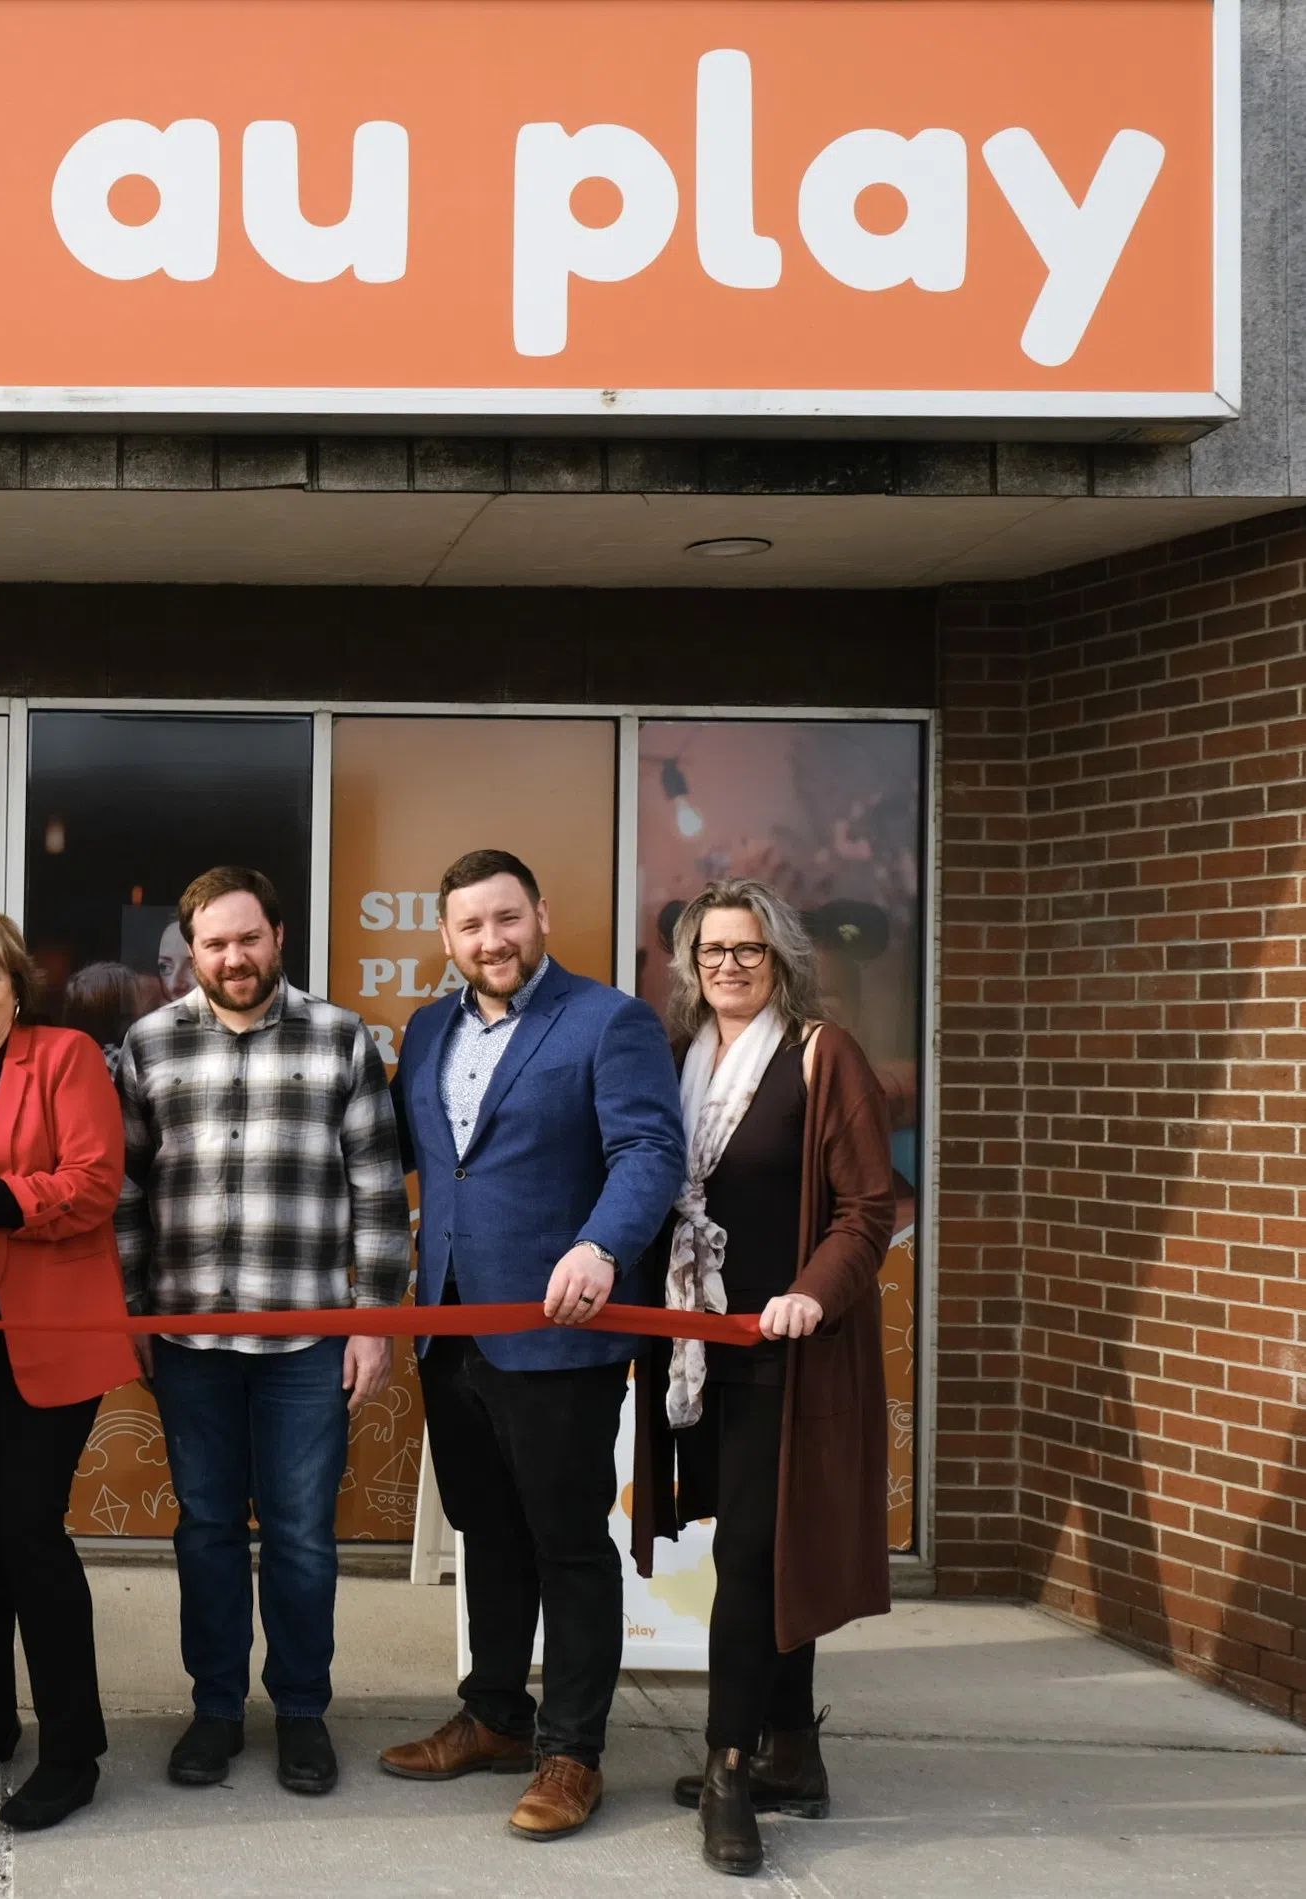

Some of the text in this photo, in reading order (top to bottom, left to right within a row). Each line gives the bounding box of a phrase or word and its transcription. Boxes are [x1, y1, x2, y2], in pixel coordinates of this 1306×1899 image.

[51, 118, 409, 283] au
[512, 48, 1166, 367] play
[358, 958, 466, 998] PLA
[628, 1624, 656, 1639] play
